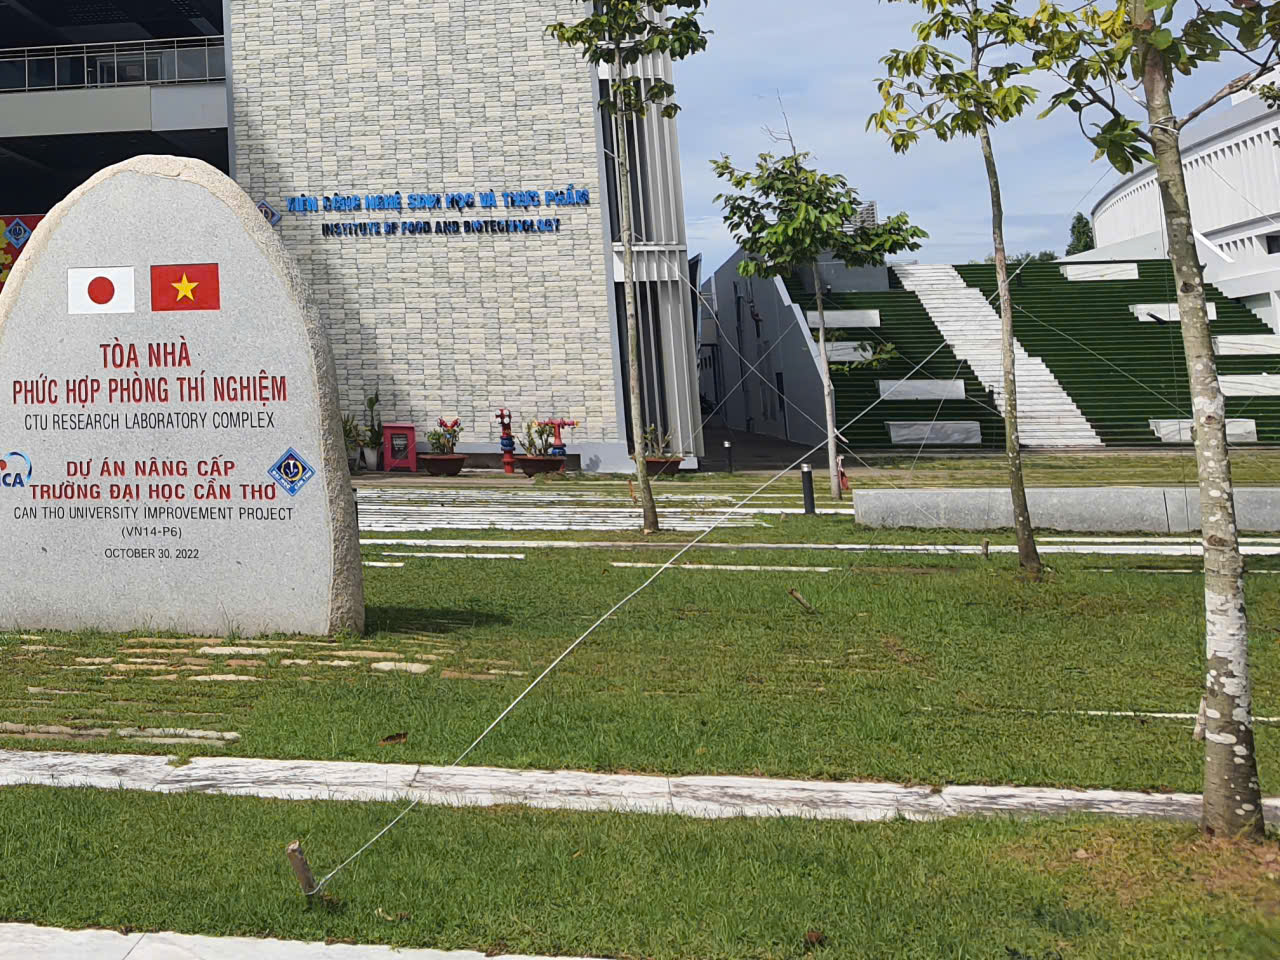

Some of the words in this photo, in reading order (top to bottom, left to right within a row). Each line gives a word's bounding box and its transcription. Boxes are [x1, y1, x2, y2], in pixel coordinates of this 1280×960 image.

[321, 222, 381, 237] INSTITUTE
[384, 221, 399, 235] OF
[401, 220, 432, 235] FOOD
[435, 220, 459, 234] AND
[463, 218, 560, 234] BIOTECHNOLOGY
[99, 336, 140, 369] TÒA
[148, 335, 192, 368] NHÀ
[12, 373, 58, 405] PHỨC
[66, 374, 101, 409] HỢP
[108, 370, 169, 403] PHÒNG
[176, 369, 206, 402] THÍ
[213, 368, 288, 407] NGHIỆM
[24, 414, 48, 431] CTU
[52, 413, 119, 431] RESEARCH
[125, 411, 207, 430] LABORATORY
[212, 411, 275, 429] COMPLEX
[66, 458, 93, 480] DỰ
[100, 456, 126, 477] ÁN
[135, 456, 188, 477] NÂNG
[197, 454, 236, 477] CẤP
[29, 480, 101, 500] TRƯỜNG
[109, 483, 140, 502] ĐẠI
[148, 483, 186, 503] HỌC
[193, 477, 232, 500] CẦN
[239, 482, 277, 500] THƠ
[13, 506, 37, 520] CAN
[41, 506, 65, 520] THO
[69, 506, 139, 520] UNIVERSITY
[143, 506, 234, 521] IMPROVEMENT
[239, 507, 293, 521] PROJECT
[121, 526, 183, 539] (VN14-P6)
[104, 548, 156, 559] OCTOBER
[175, 548, 199, 559] 2022
